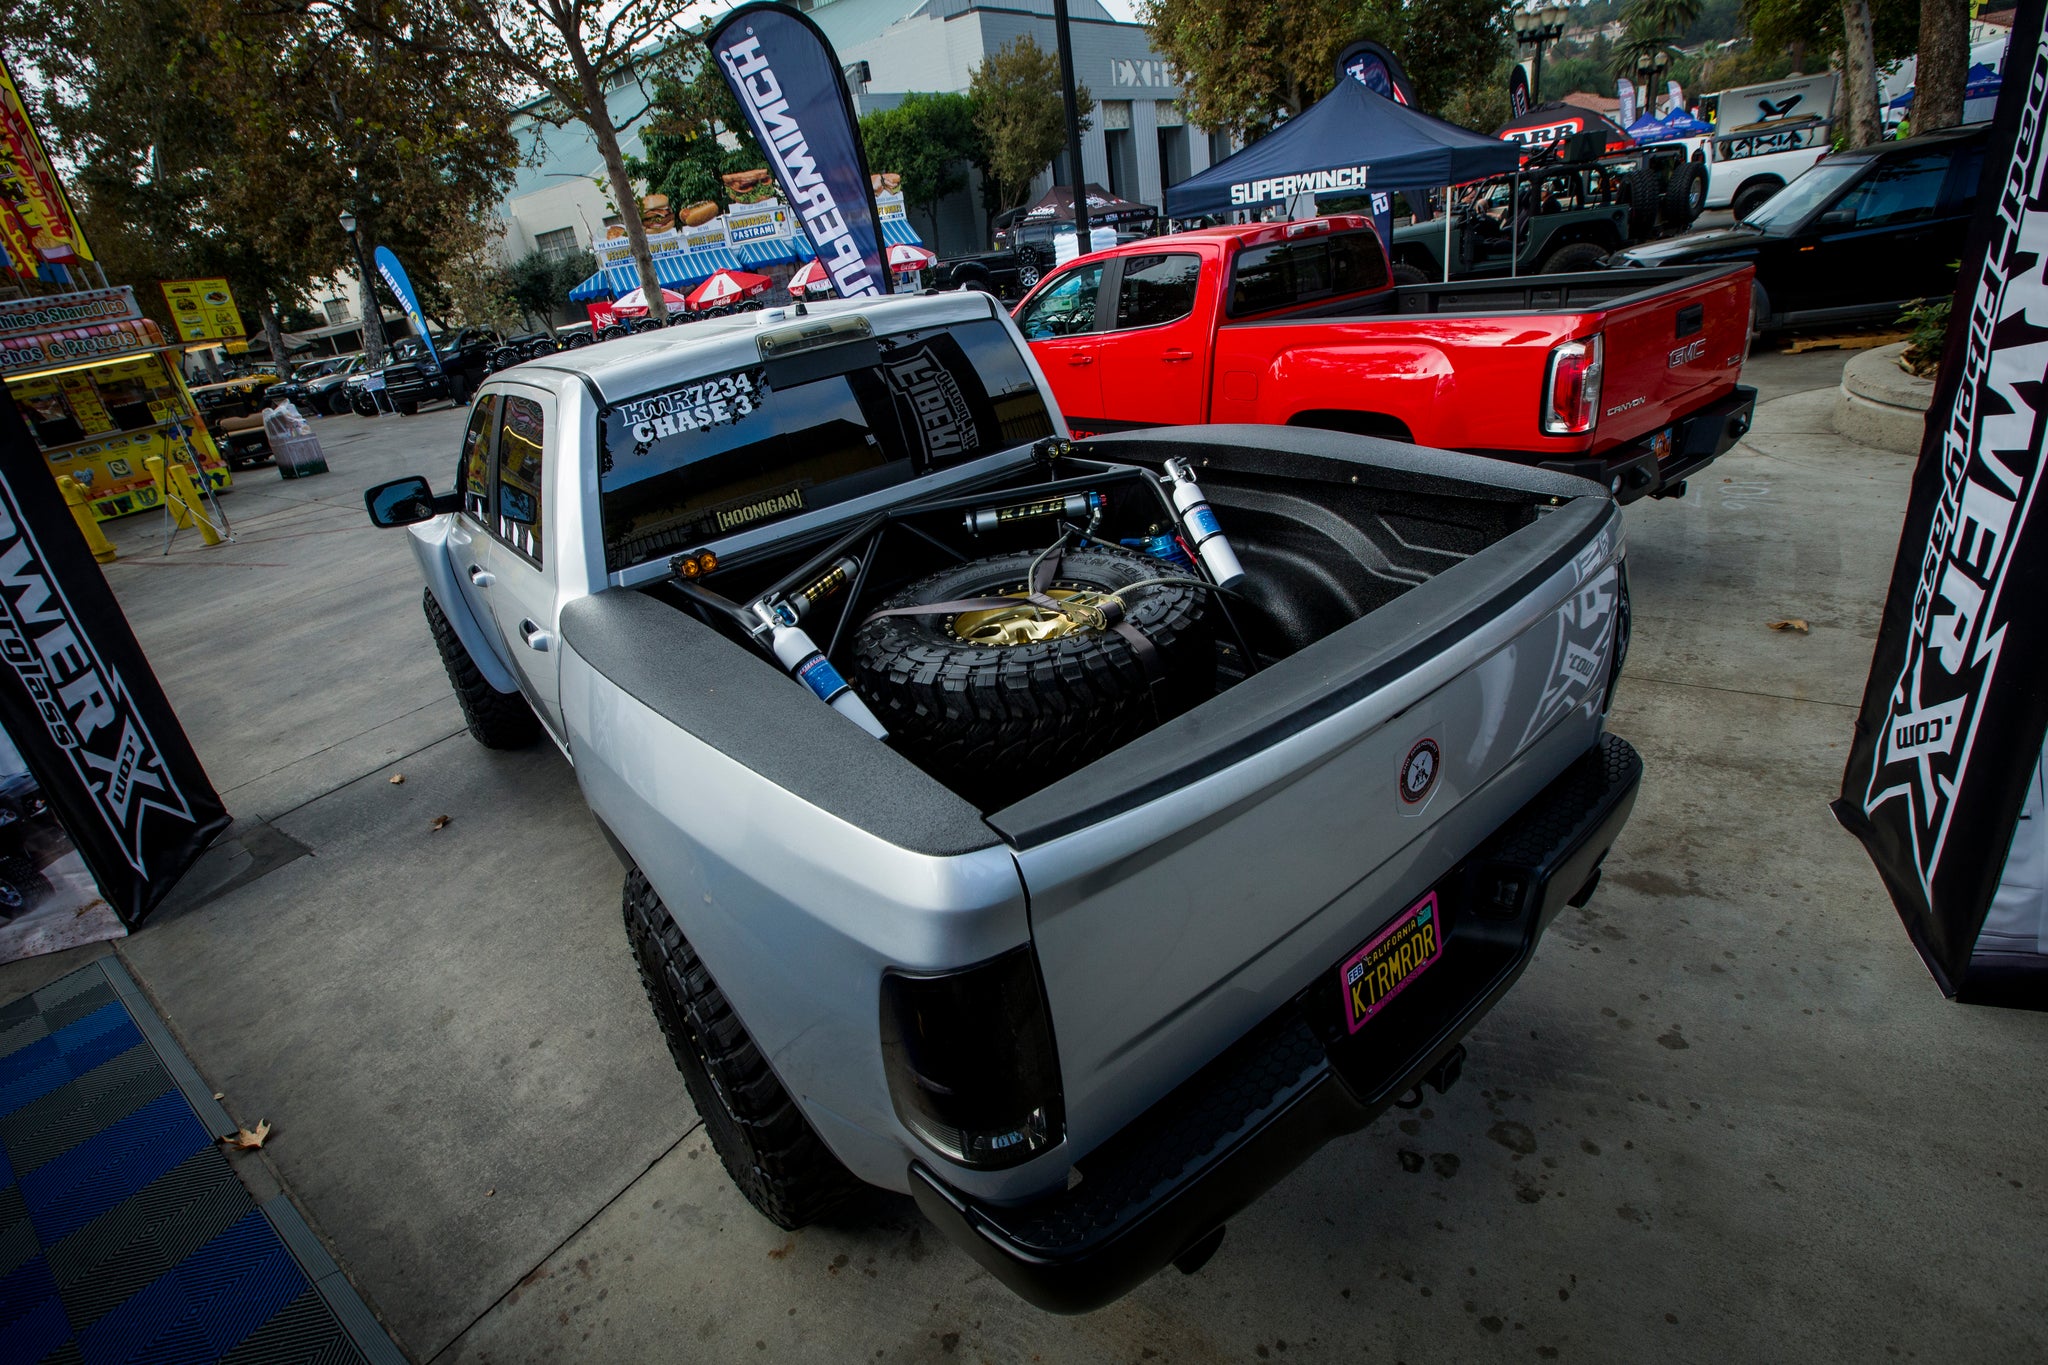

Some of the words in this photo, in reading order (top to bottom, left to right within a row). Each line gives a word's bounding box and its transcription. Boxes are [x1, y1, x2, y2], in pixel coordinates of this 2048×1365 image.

[1511, 125, 1574, 145] ARB
[1231, 166, 1367, 205] SUPERWINCH
[733, 224, 775, 240] PASTRAMI
[0, 311, 35, 329] hies
[49, 301, 101, 320] Shaved
[102, 299, 127, 315] Ice
[0, 346, 44, 365] chos
[65, 331, 137, 356] Pretzels
[1668, 338, 1706, 369] GMC
[632, 400, 732, 443] CHASE
[734, 395, 753, 415] 3
[1606, 396, 1646, 416] CANYON
[1000, 500, 1063, 520] KING
[0, 508, 166, 828] WERX
[0, 604, 75, 748] rglass
[1367, 919, 1417, 966] CALIFORNIA
[1348, 964, 1364, 984] FEB
[1352, 923, 1436, 1019] KTRMRDR
